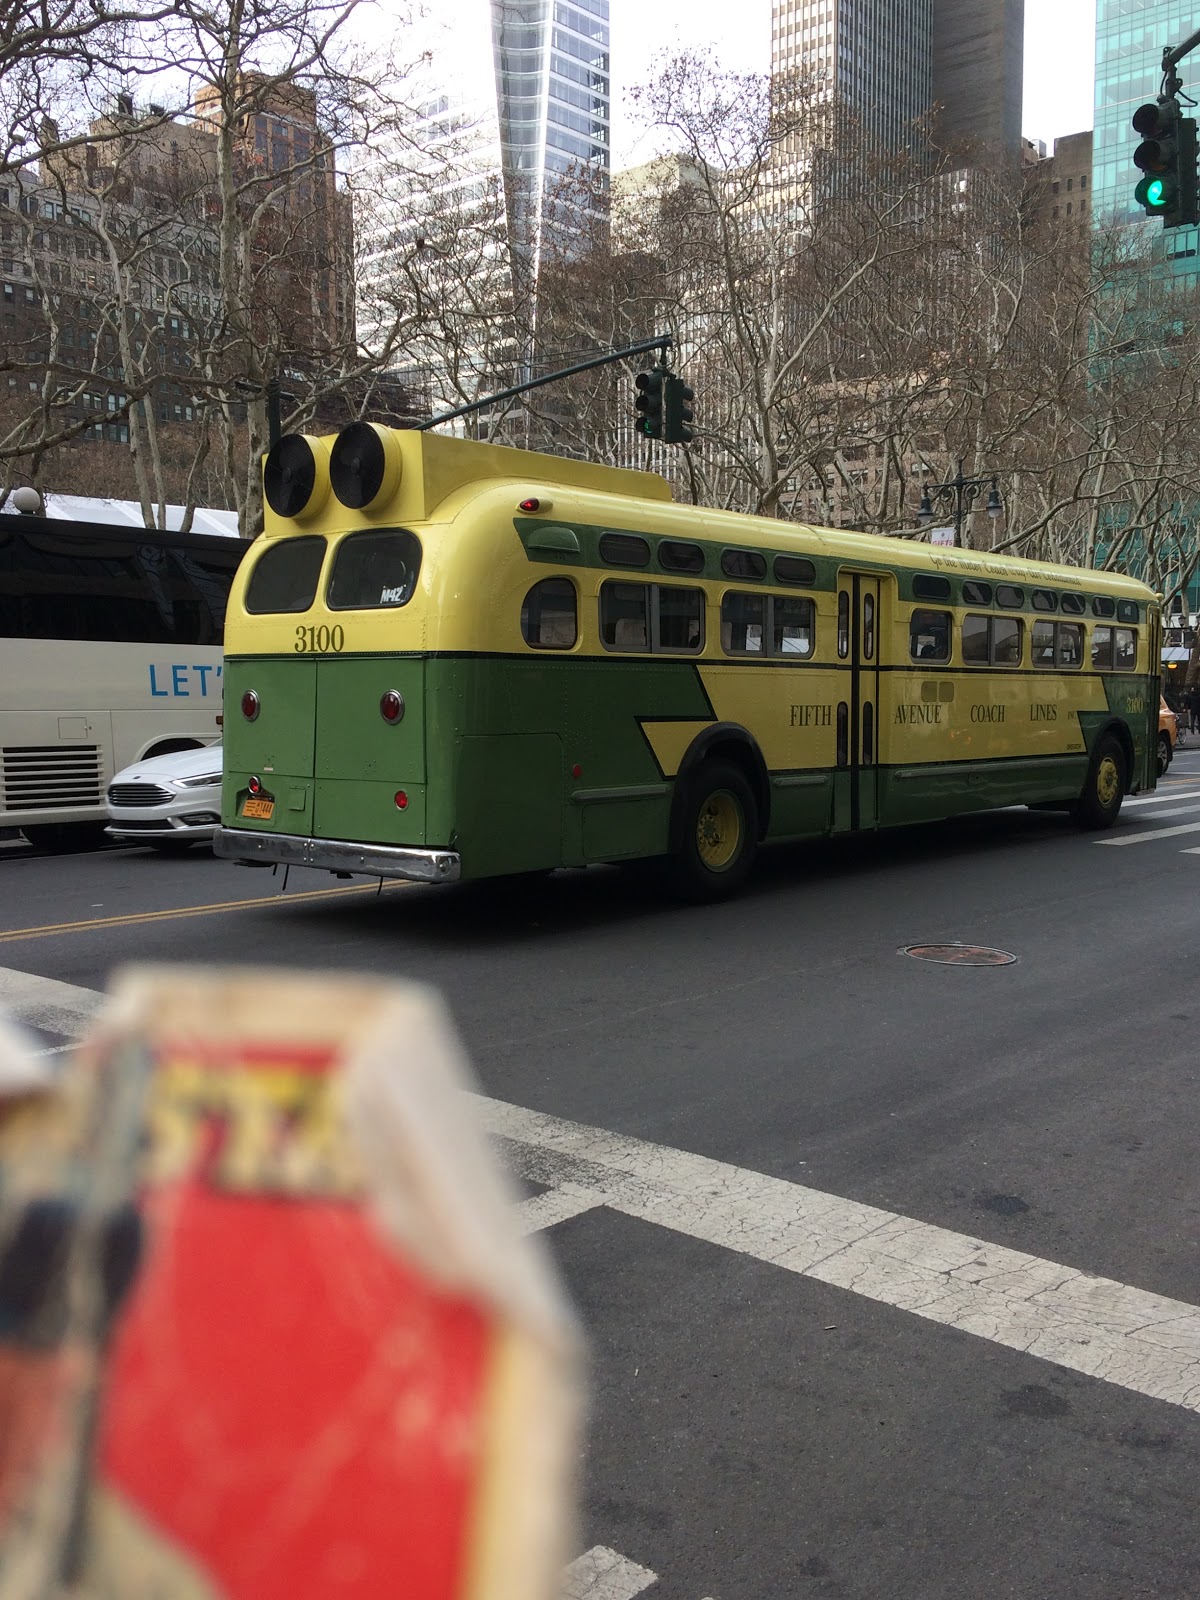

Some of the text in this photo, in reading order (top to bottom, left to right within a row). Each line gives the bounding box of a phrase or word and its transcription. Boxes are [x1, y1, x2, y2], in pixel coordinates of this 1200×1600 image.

[380, 586, 404, 602] M42
[294, 624, 345, 653] 3100
[789, 704, 832, 727] FIFTH
[894, 704, 942, 725] AVENUE
[970, 704, 1006, 723] COACH
[1030, 703, 1058, 722] LINES
[1125, 697, 1144, 714] 3100
